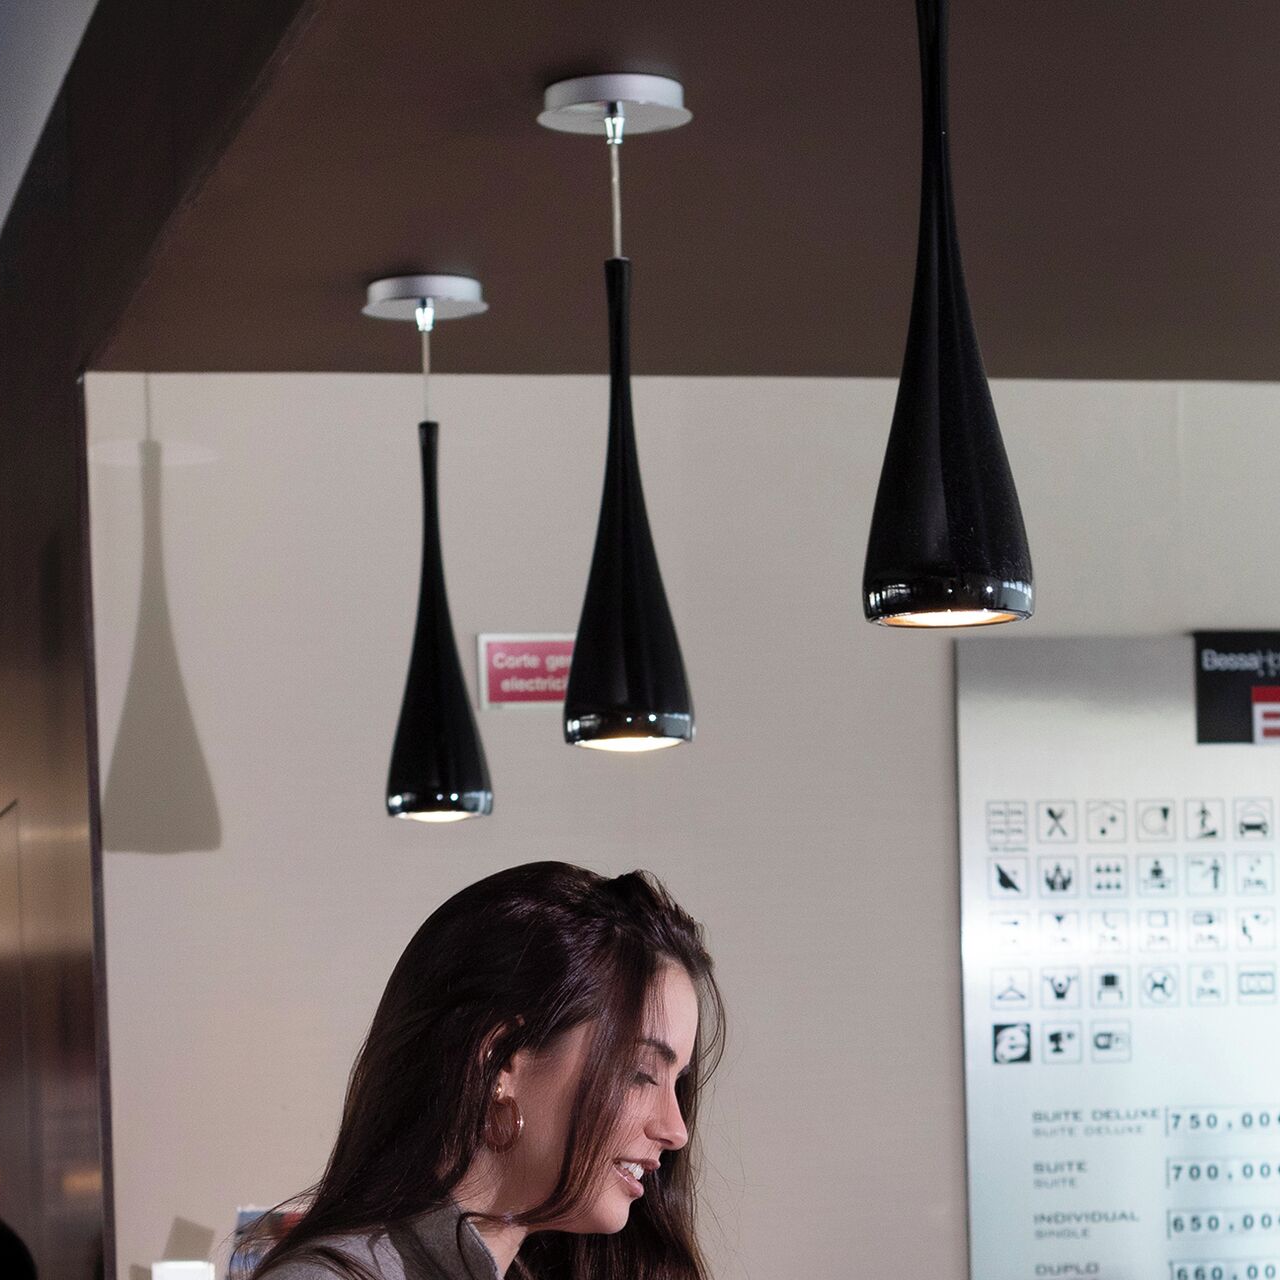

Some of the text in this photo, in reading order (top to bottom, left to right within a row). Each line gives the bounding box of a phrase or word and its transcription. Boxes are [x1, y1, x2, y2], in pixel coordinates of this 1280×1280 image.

[492, 652, 541, 669] Corte
[1032, 1108, 1159, 1122] SUITE DELUXE
[1033, 1125, 1143, 1138] SUITE DELUXE
[1033, 1160, 1087, 1174] SUITE
[1033, 1210, 1140, 1224] INDIVIDUAL
[1034, 1262, 1100, 1276] DUPLO
